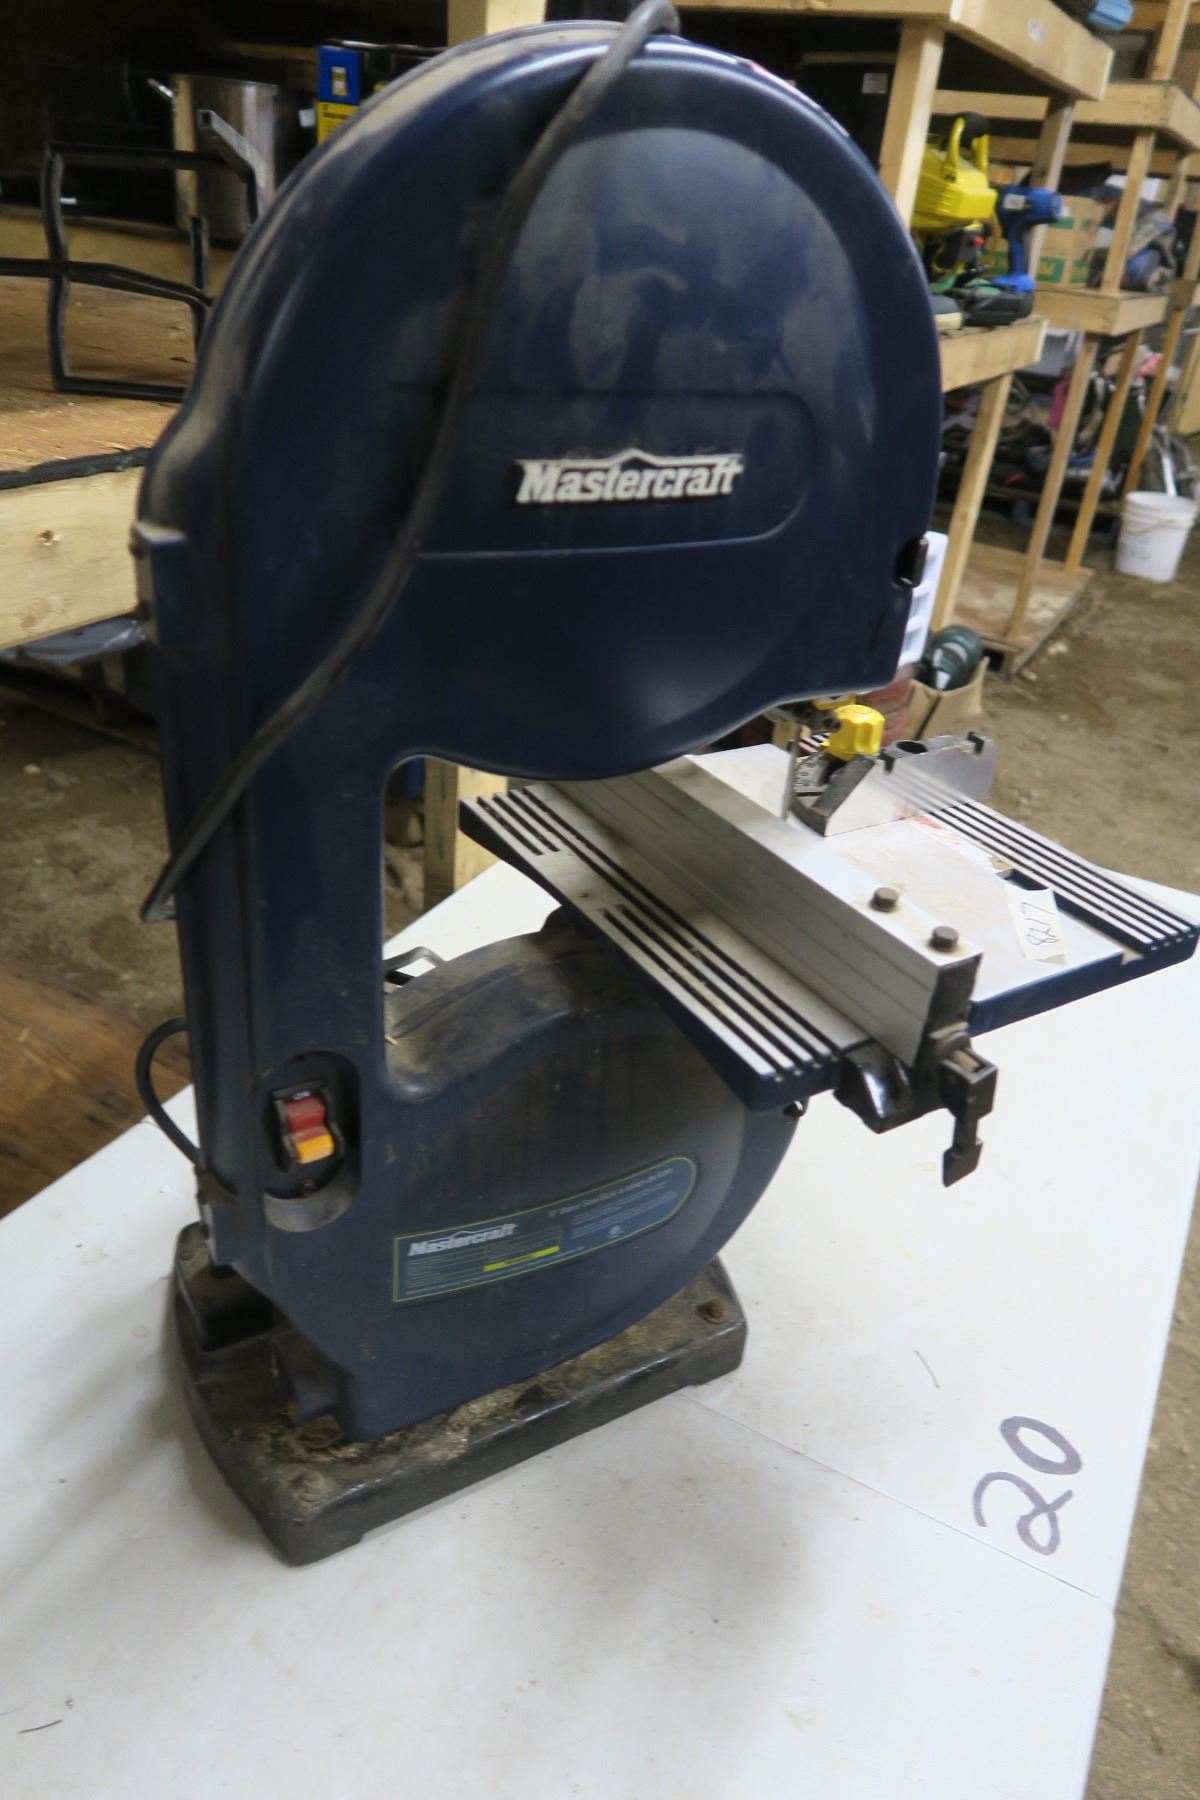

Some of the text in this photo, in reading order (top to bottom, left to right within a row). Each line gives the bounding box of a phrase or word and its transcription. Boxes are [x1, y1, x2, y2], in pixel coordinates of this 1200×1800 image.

[515, 449, 744, 503] Mastercraft
[408, 1223, 518, 1257] Mastercraft
[972, 1415, 1082, 1555] 20
